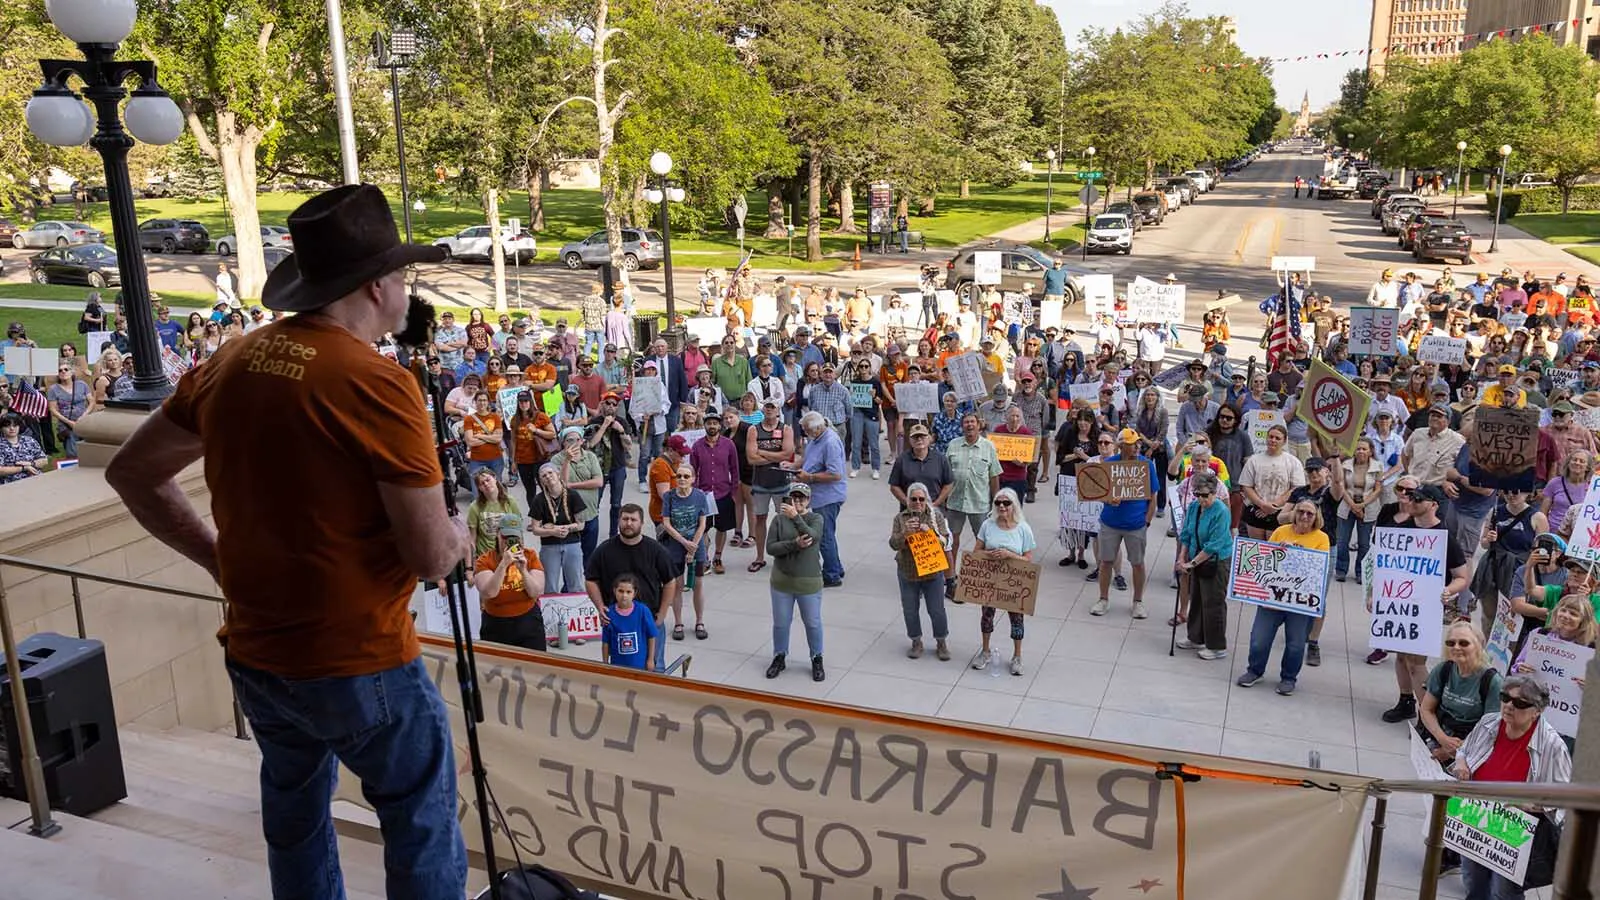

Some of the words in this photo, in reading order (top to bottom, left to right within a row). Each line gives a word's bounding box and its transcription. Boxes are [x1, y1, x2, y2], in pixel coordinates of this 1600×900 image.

[1361, 315, 1373, 344] BODY
[1380, 315, 1392, 352] CHOICE
[269, 334, 318, 361] Free
[1419, 350, 1445, 361] Public
[1446, 352, 1462, 362] Jobs
[248, 351, 305, 381] Roam
[1478, 421, 1505, 433] KEEP
[1507, 423, 1530, 435] OUR
[1479, 433, 1530, 452] WEST
[1475, 449, 1525, 466] WILD
[1111, 464, 1146, 478] HANDS
[1113, 486, 1145, 498] LANDS
[1060, 512, 1080, 526] NOT
[1380, 532, 1414, 551] KEEP
[1415, 535, 1438, 550] WY
[962, 554, 1000, 574] SENATOR
[1237, 543, 1287, 576] KEEP
[1377, 554, 1442, 577] BEAUTIFUL
[1254, 571, 1308, 590] Wyoming
[1268, 585, 1320, 607] WILD
[579, 606, 595, 616] FOR
[1376, 601, 1419, 617] LAND
[568, 616, 599, 632] ALE!
[1371, 619, 1419, 640] GRAB
[1532, 637, 1577, 661] BARRASSO
[1541, 659, 1565, 678] SAVE
[1549, 699, 1580, 716] NDS
[1445, 830, 1455, 841] IN
[1456, 835, 1484, 855] PUBLIC
[1485, 849, 1516, 871] HANDS!
[1466, 827, 1492, 846] PUBLIC
[1494, 841, 1519, 860] LANDS
